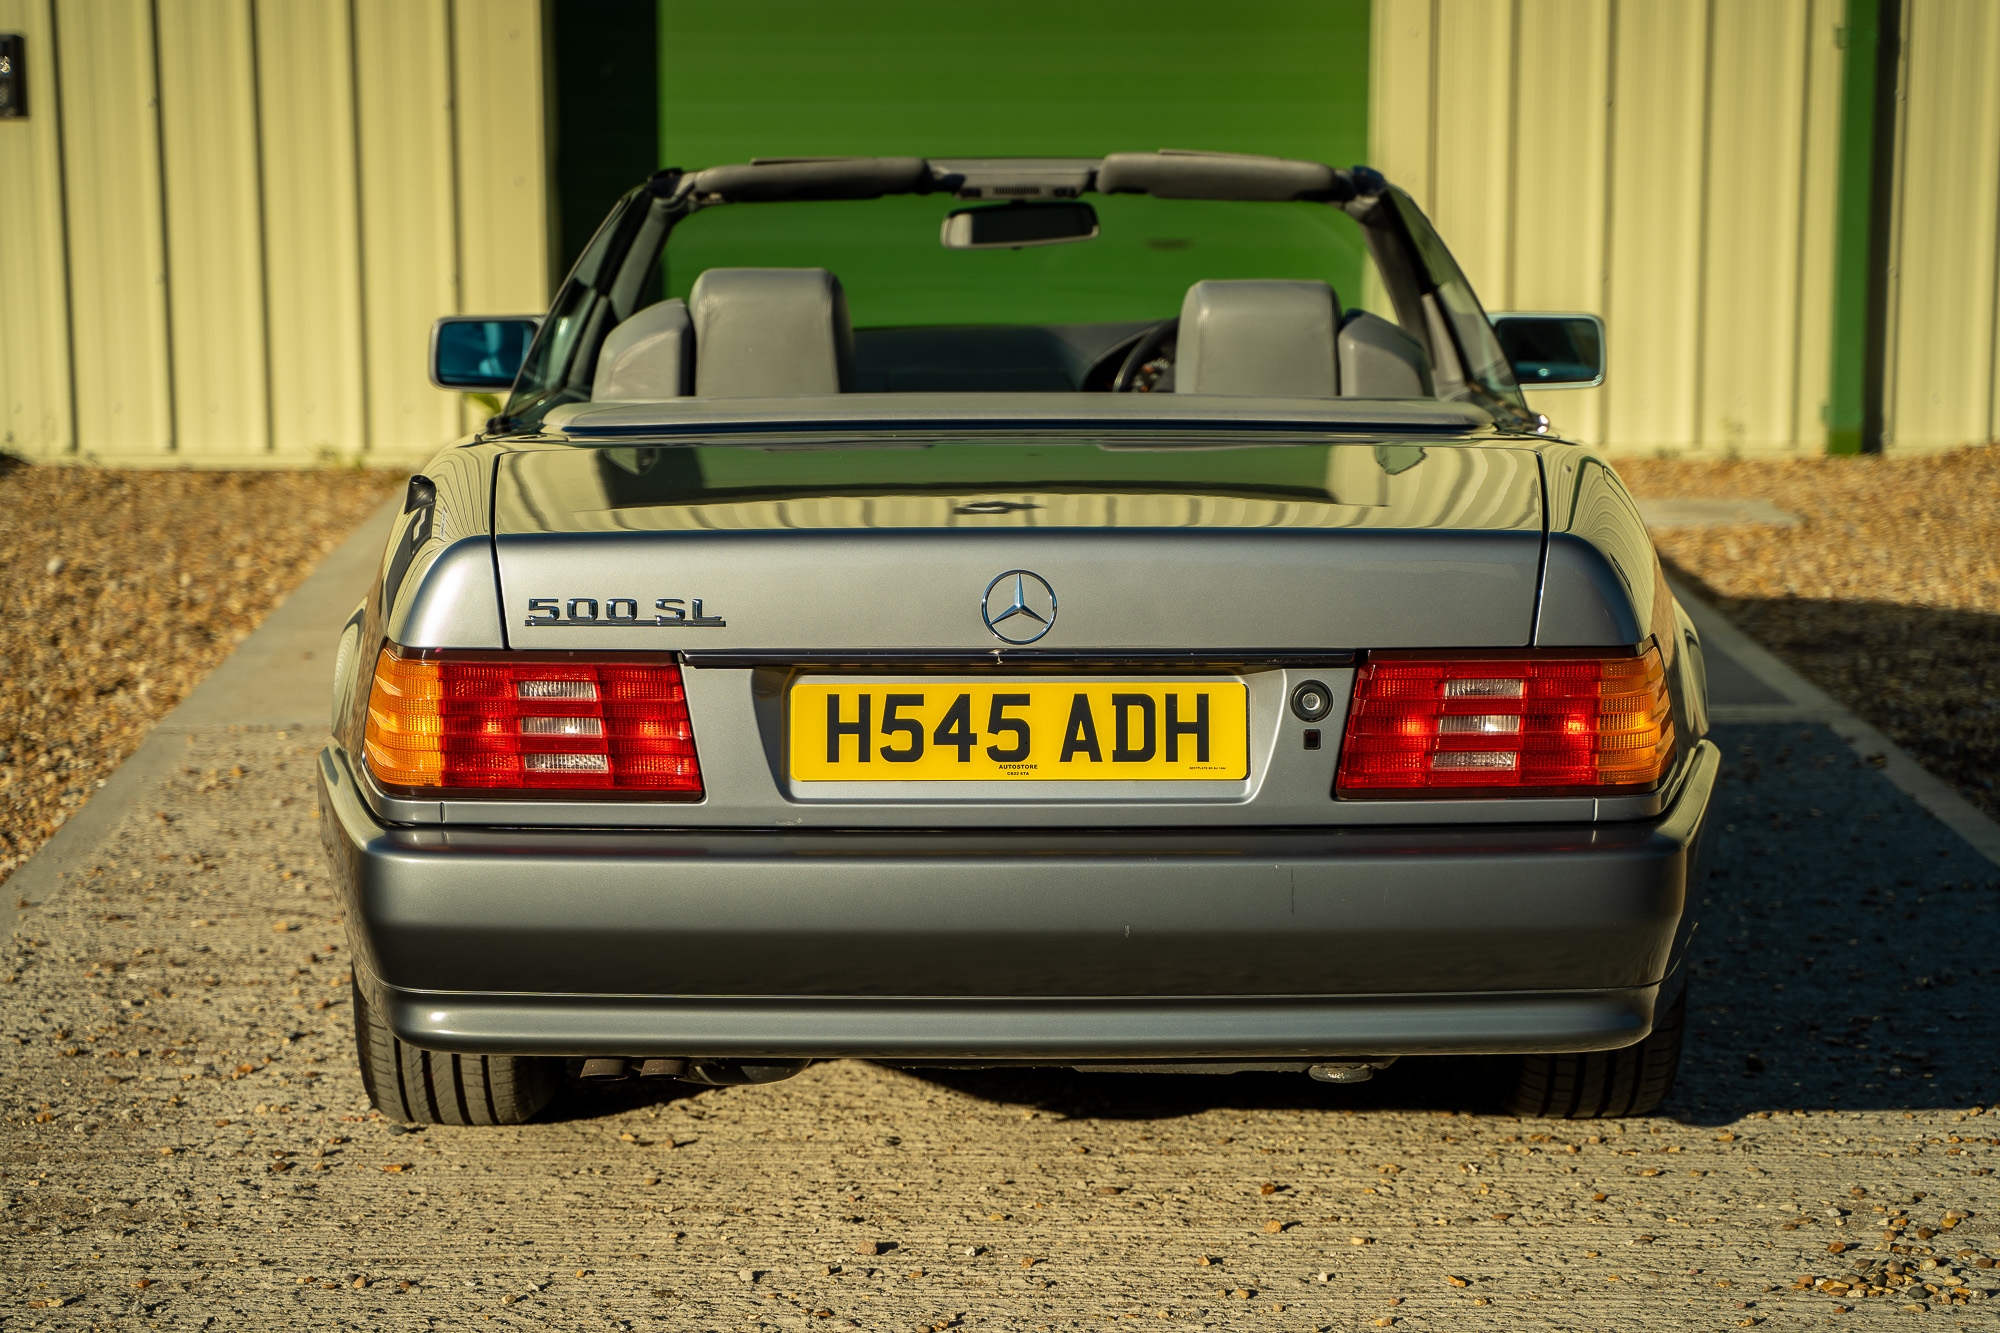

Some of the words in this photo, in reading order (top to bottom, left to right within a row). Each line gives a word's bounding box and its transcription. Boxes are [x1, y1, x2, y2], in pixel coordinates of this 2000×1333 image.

[528, 598, 638, 621] 500
[655, 598, 723, 621] SL
[826, 693, 1031, 763] H545
[1059, 693, 1210, 763] ADH
